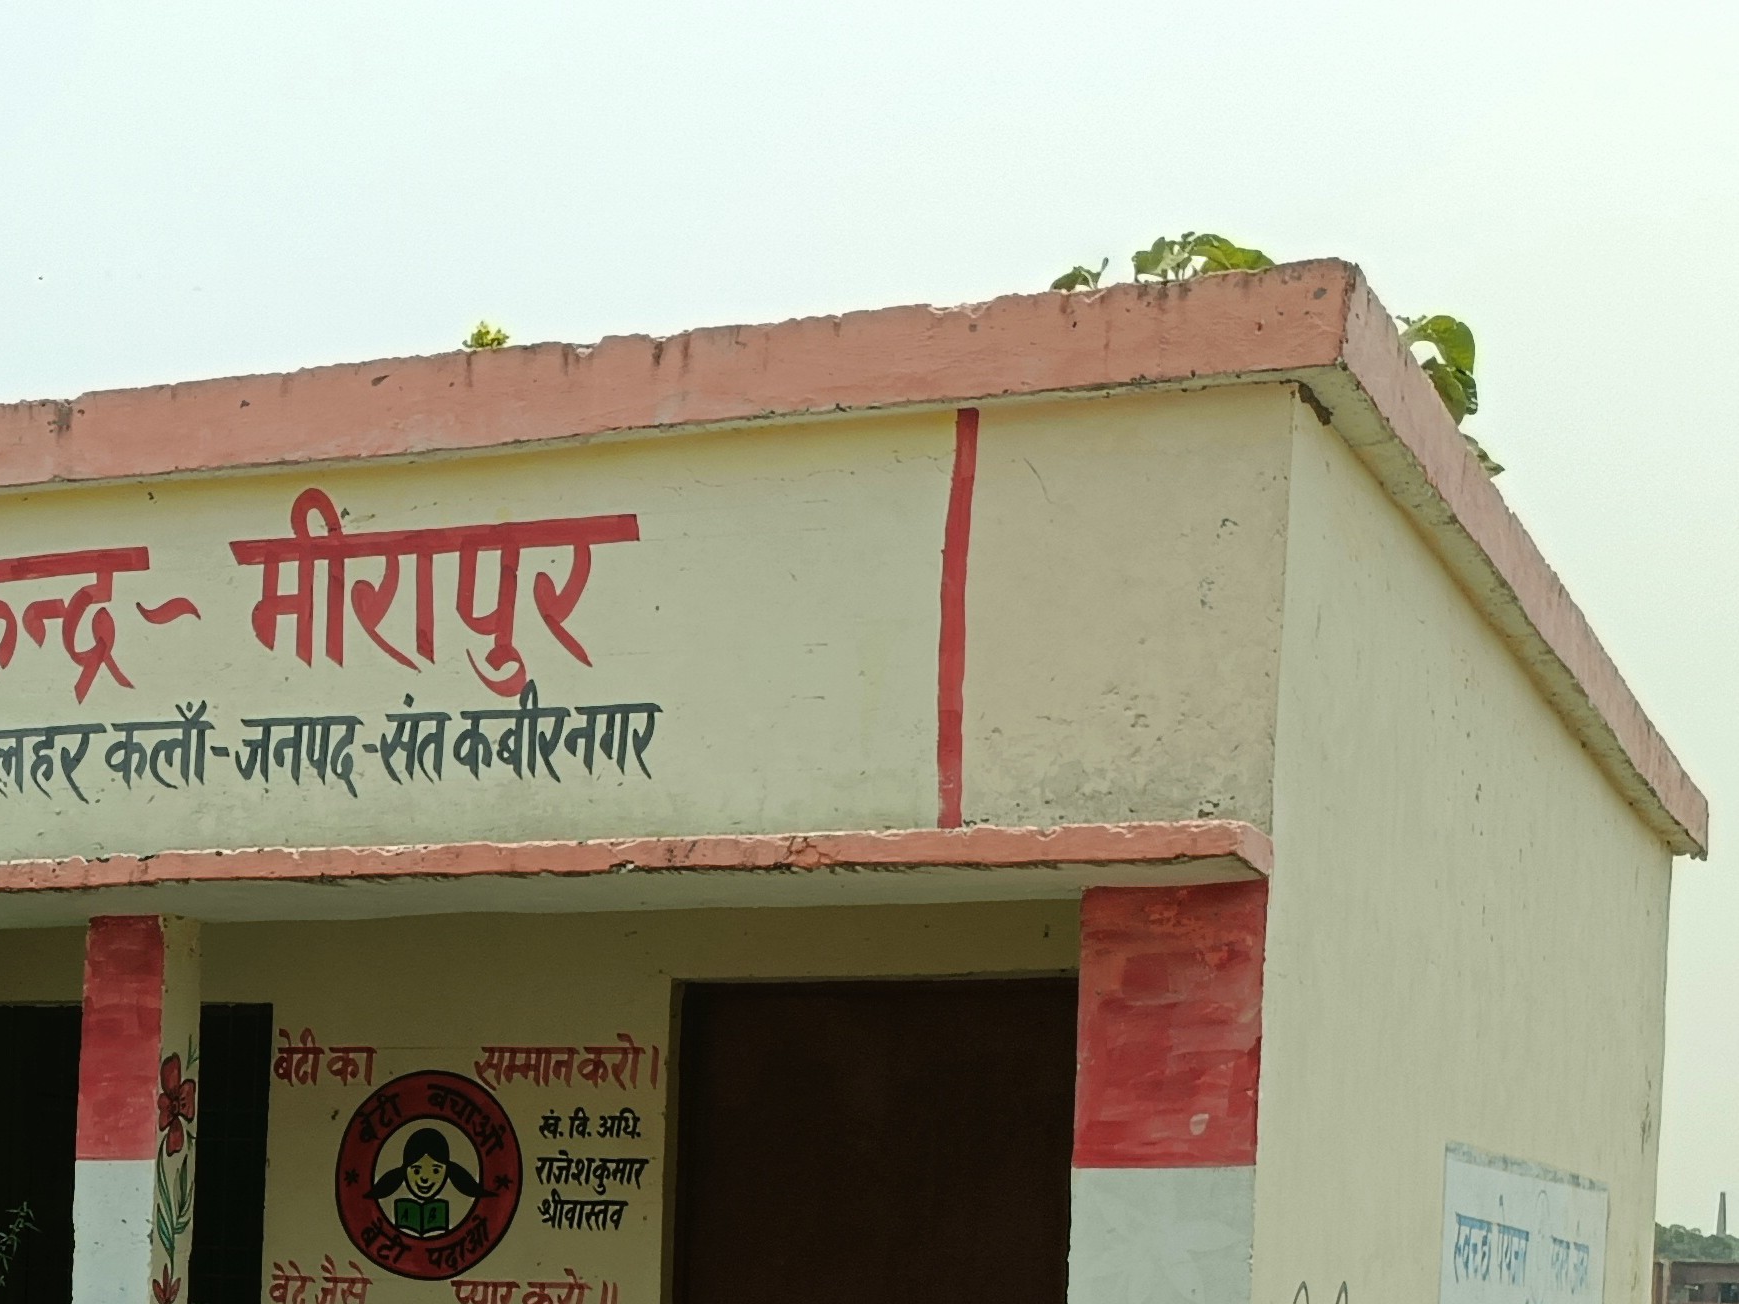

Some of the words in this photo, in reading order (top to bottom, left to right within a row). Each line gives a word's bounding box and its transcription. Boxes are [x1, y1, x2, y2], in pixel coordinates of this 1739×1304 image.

[230, 487, 640, 699] मीरापुर
[273, 1027, 325, 1087] बेटी
[326, 1046, 378, 1087] का
[474, 1046, 580, 1092] सम्मान
[537, 1189, 629, 1231] श्रीवास्तव
